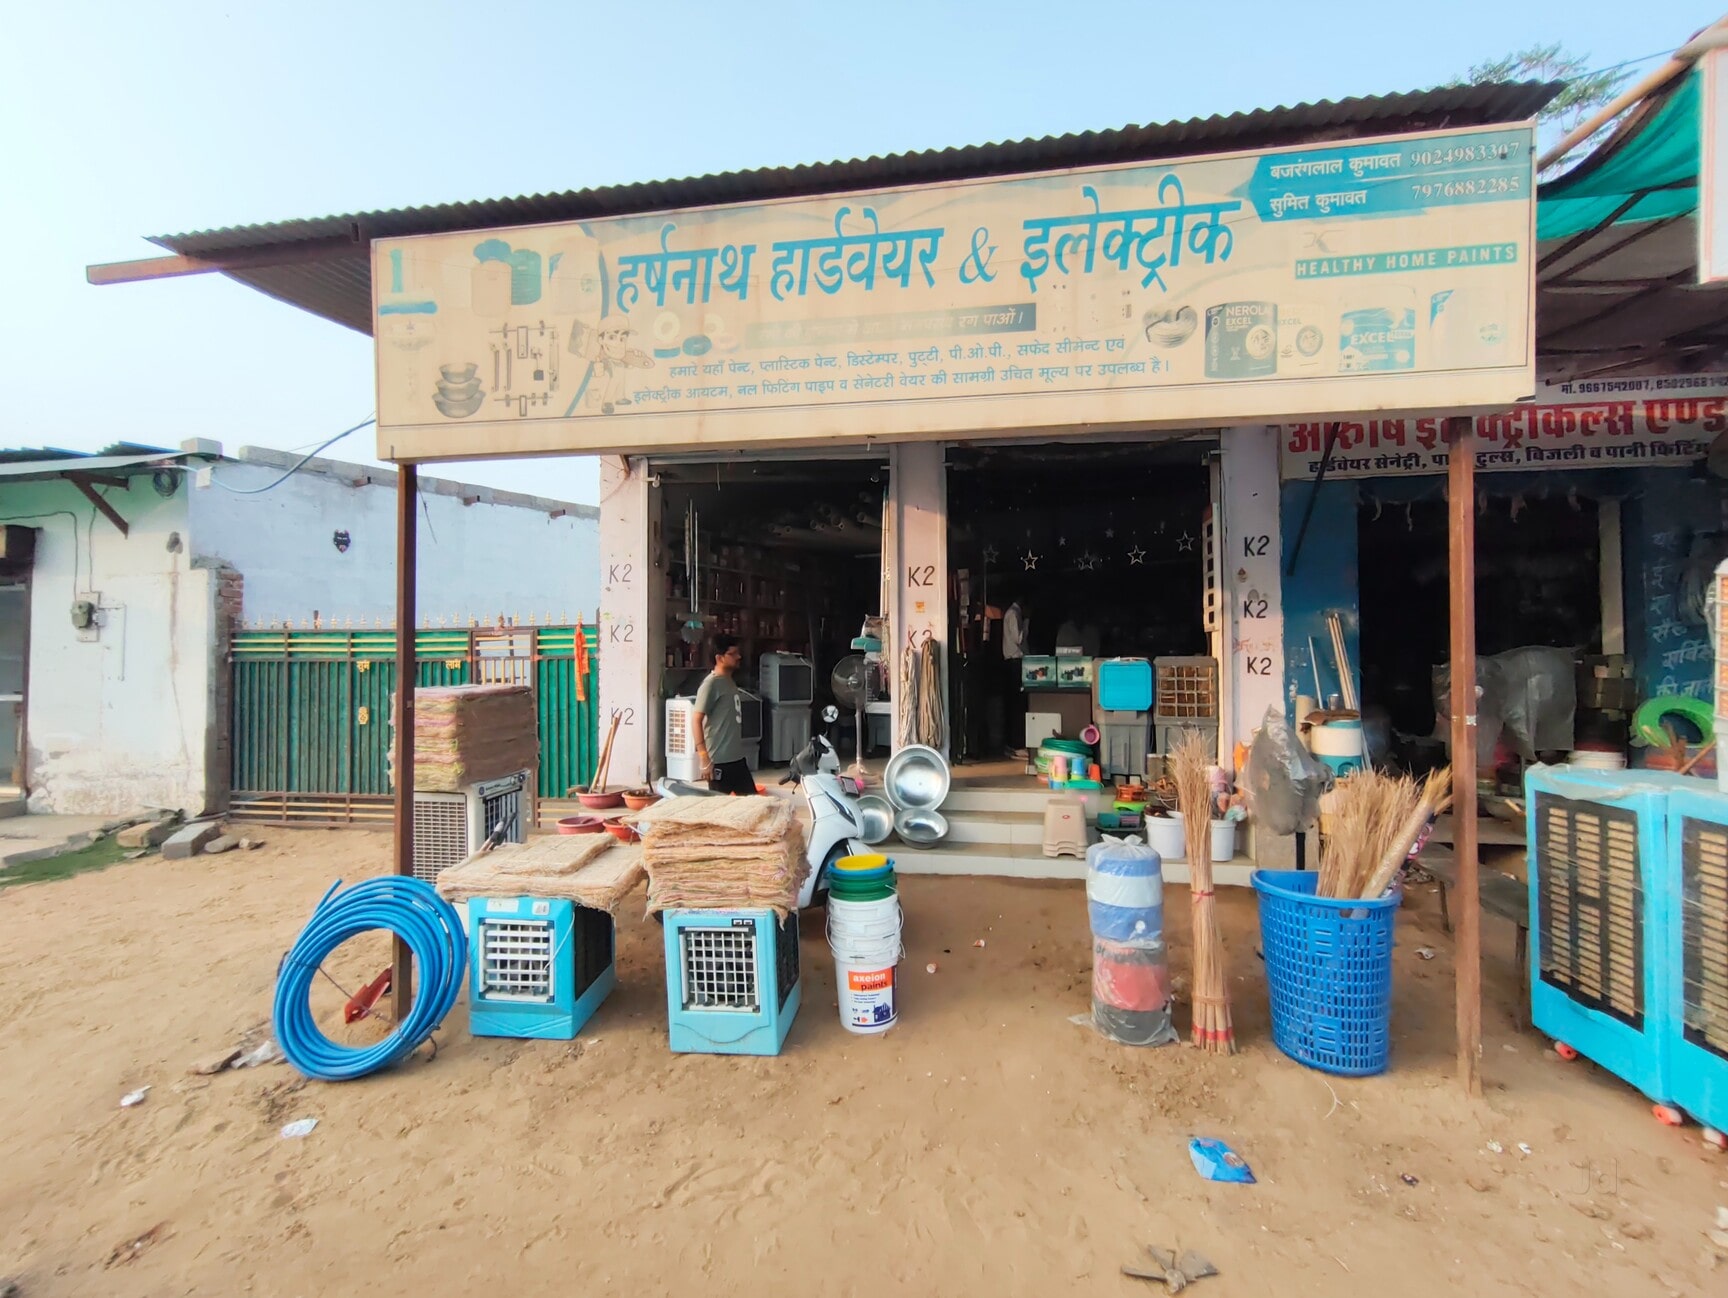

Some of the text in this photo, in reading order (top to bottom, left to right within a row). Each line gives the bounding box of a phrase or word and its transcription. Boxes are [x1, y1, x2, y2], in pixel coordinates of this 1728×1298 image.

[1270, 142, 1520, 179] बजरंगलाल कुमावत 9024983307
[1269, 176, 1520, 217] सुमित कुमावत 7976882285
[616, 173, 1242, 313] हर्षनाथ हार्डवेयर & इलेक्ट्रीक
[1296, 244, 1516, 276] HEALTHY HOME PAINTS
[1226, 304, 1270, 317] NEROL
[1350, 331, 1396, 346] EXCEL
[669, 361, 698, 378] हमारे
[702, 359, 724, 375] यहाँ
[728, 359, 755, 375] पेन्ट,
[759, 355, 810, 372] प्लास्टिक
[847, 349, 903, 366] डिस्टेम्पर,
[1017, 339, 1050, 356] सफेद
[1056, 336, 1100, 354] सीमेन्ट
[1105, 334, 1125, 351] एवं
[633, 386, 682, 405] इलेक्ट्रीक
[686, 385, 733, 400] आयटम,
[737, 383, 757, 396] नल
[762, 379, 800, 395] फिटिंग
[805, 378, 835, 394] पाइप
[839, 379, 848, 391] व
[853, 373, 894, 390] सेनेटरी
[899, 371, 926, 388] वेयर
[931, 367, 948, 385] की
[952, 365, 996, 384] सामग्री
[1000, 364, 1033, 380] उचित
[1038, 364, 1070, 383] मूल्य
[1074, 363, 1093, 377] पर
[1098, 358, 1146, 376] उपलब्ध
[1526, 445, 1586, 462] बिजली
[1590, 447, 1601, 460] व
[1606, 442, 1648, 458] पानी
[1244, 536, 1271, 557] K2
[608, 563, 633, 583] K2
[907, 565, 936, 587] K2
[1243, 600, 1269, 620] K2
[610, 623, 634, 643] K2
[1246, 657, 1272, 676] K2
[611, 707, 635, 726] K2
[861, 981, 888, 992] paints
